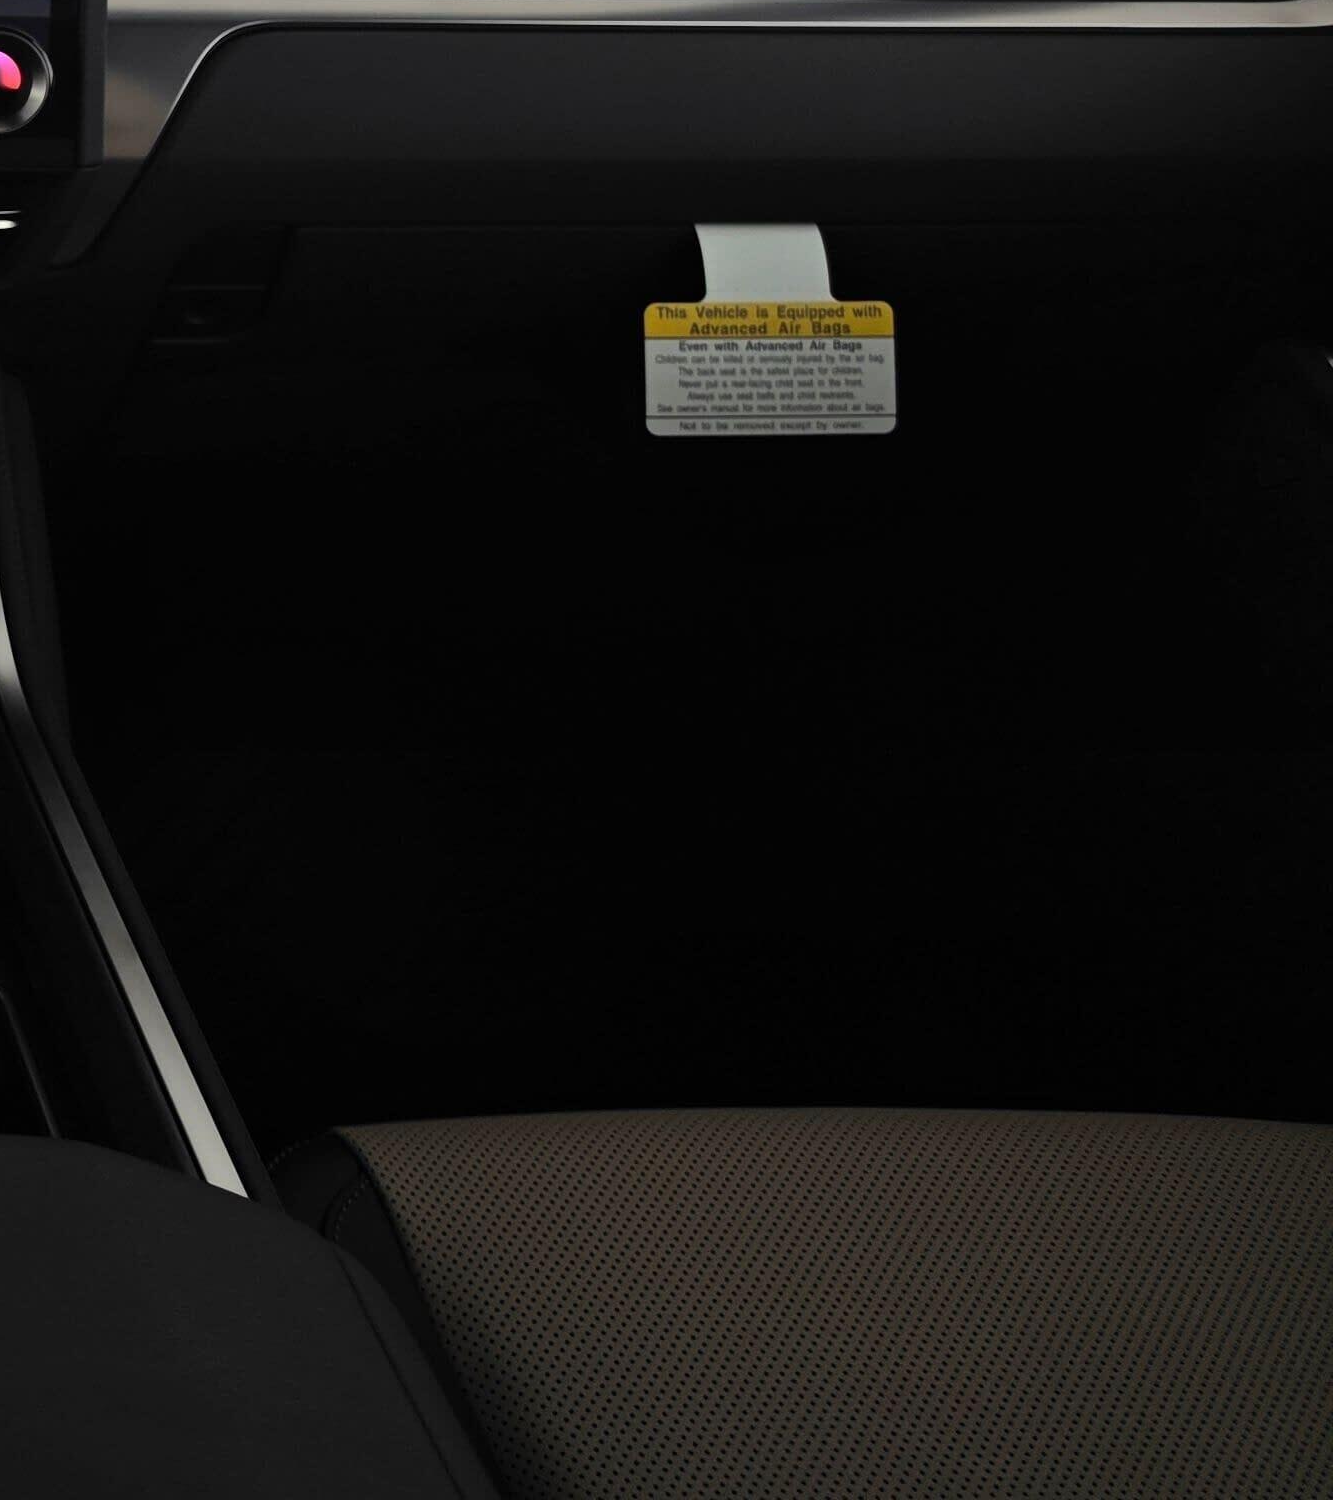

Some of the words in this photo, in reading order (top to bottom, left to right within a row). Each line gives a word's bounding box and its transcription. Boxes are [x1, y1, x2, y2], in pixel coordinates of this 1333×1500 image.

[656, 306, 688, 319] This
[694, 305, 749, 318] Vehicle
[756, 305, 770, 318] is
[776, 305, 845, 321] Equipped
[851, 304, 883, 317] with
[689, 322, 768, 334] Advanced
[778, 322, 802, 334] Air
[811, 321, 851, 336] Bags
[678, 342, 709, 352] Even
[714, 341, 739, 351] with
[745, 341, 804, 351] Advanced
[809, 341, 826, 351] Air
[832, 340, 863, 353] Bags
